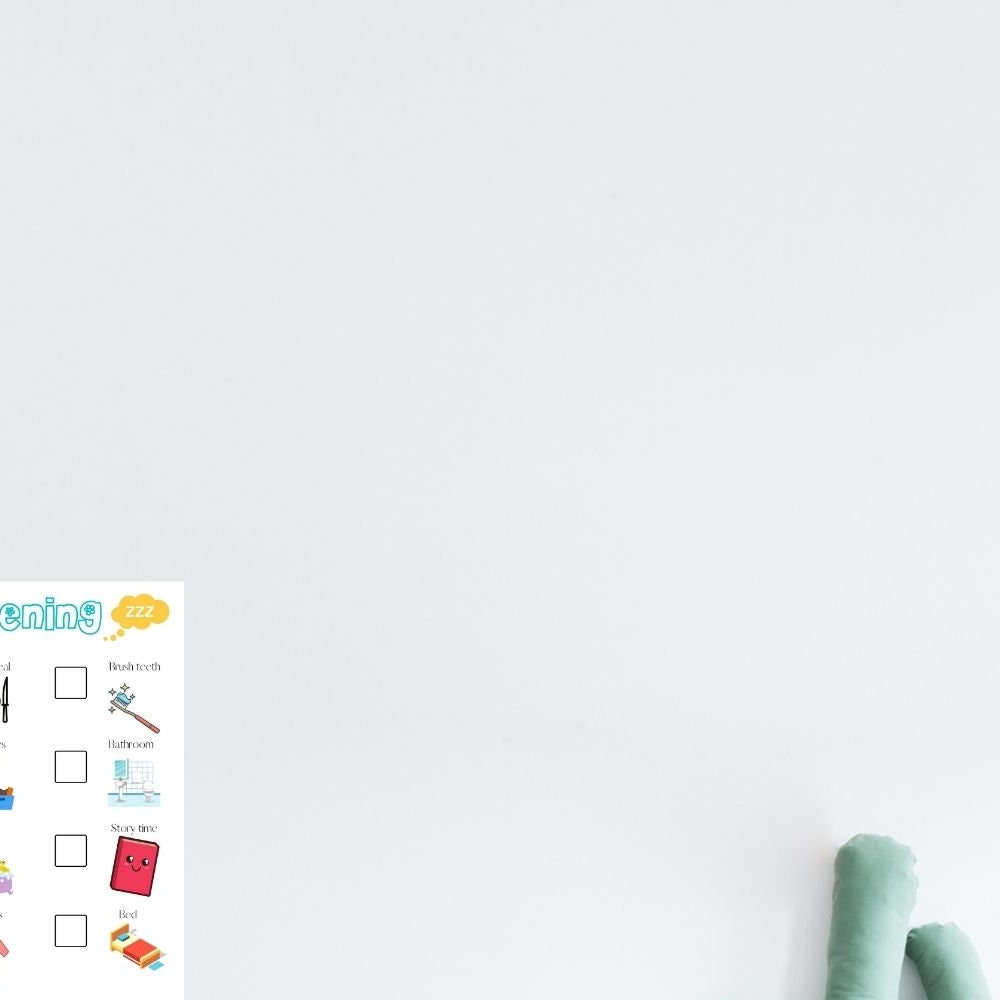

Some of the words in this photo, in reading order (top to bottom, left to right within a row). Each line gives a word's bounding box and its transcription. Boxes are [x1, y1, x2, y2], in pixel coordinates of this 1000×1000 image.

[109, 661, 134, 672] Brush
[136, 661, 161, 672] teeth
[108, 739, 154, 750] Bathroom
[110, 823, 136, 835] Story
[138, 823, 158, 833] time
[119, 909, 138, 920] Bed
